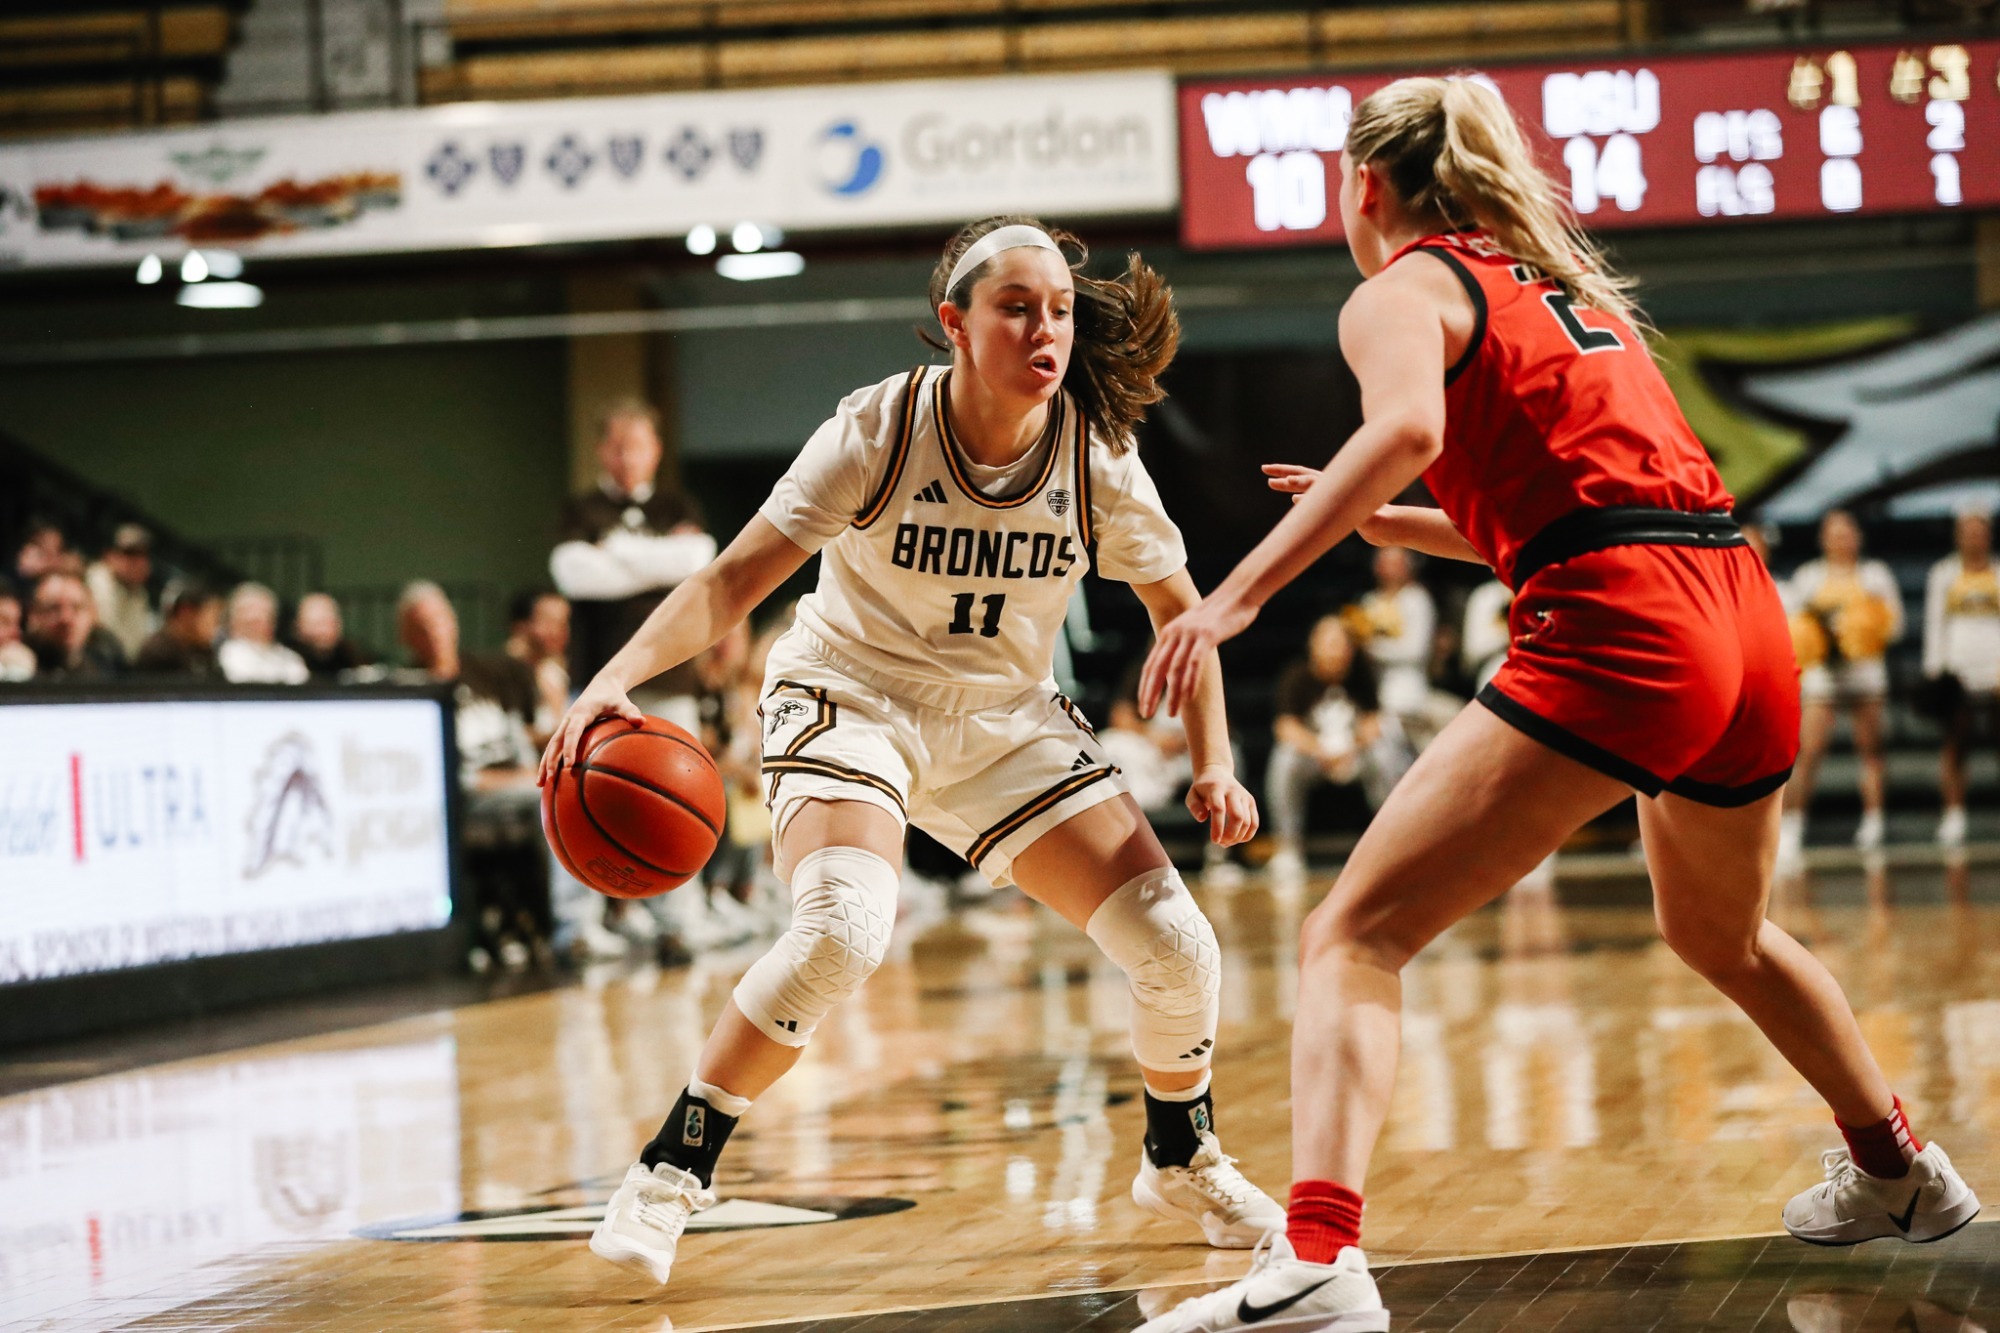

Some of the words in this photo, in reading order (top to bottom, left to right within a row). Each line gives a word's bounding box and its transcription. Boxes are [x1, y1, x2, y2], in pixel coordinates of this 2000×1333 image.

[900, 105, 1155, 177] Gordon
[1201, 86, 1351, 157] WMU
[1926, 99, 1965, 152] 2
[1246, 151, 1326, 231] 10
[1563, 133, 1647, 214] 14
[1929, 153, 1963, 206] 1
[891, 522, 1076, 579] BRONCOS
[949, 592, 1006, 638] 11
[92, 763, 212, 849] ULTRA
